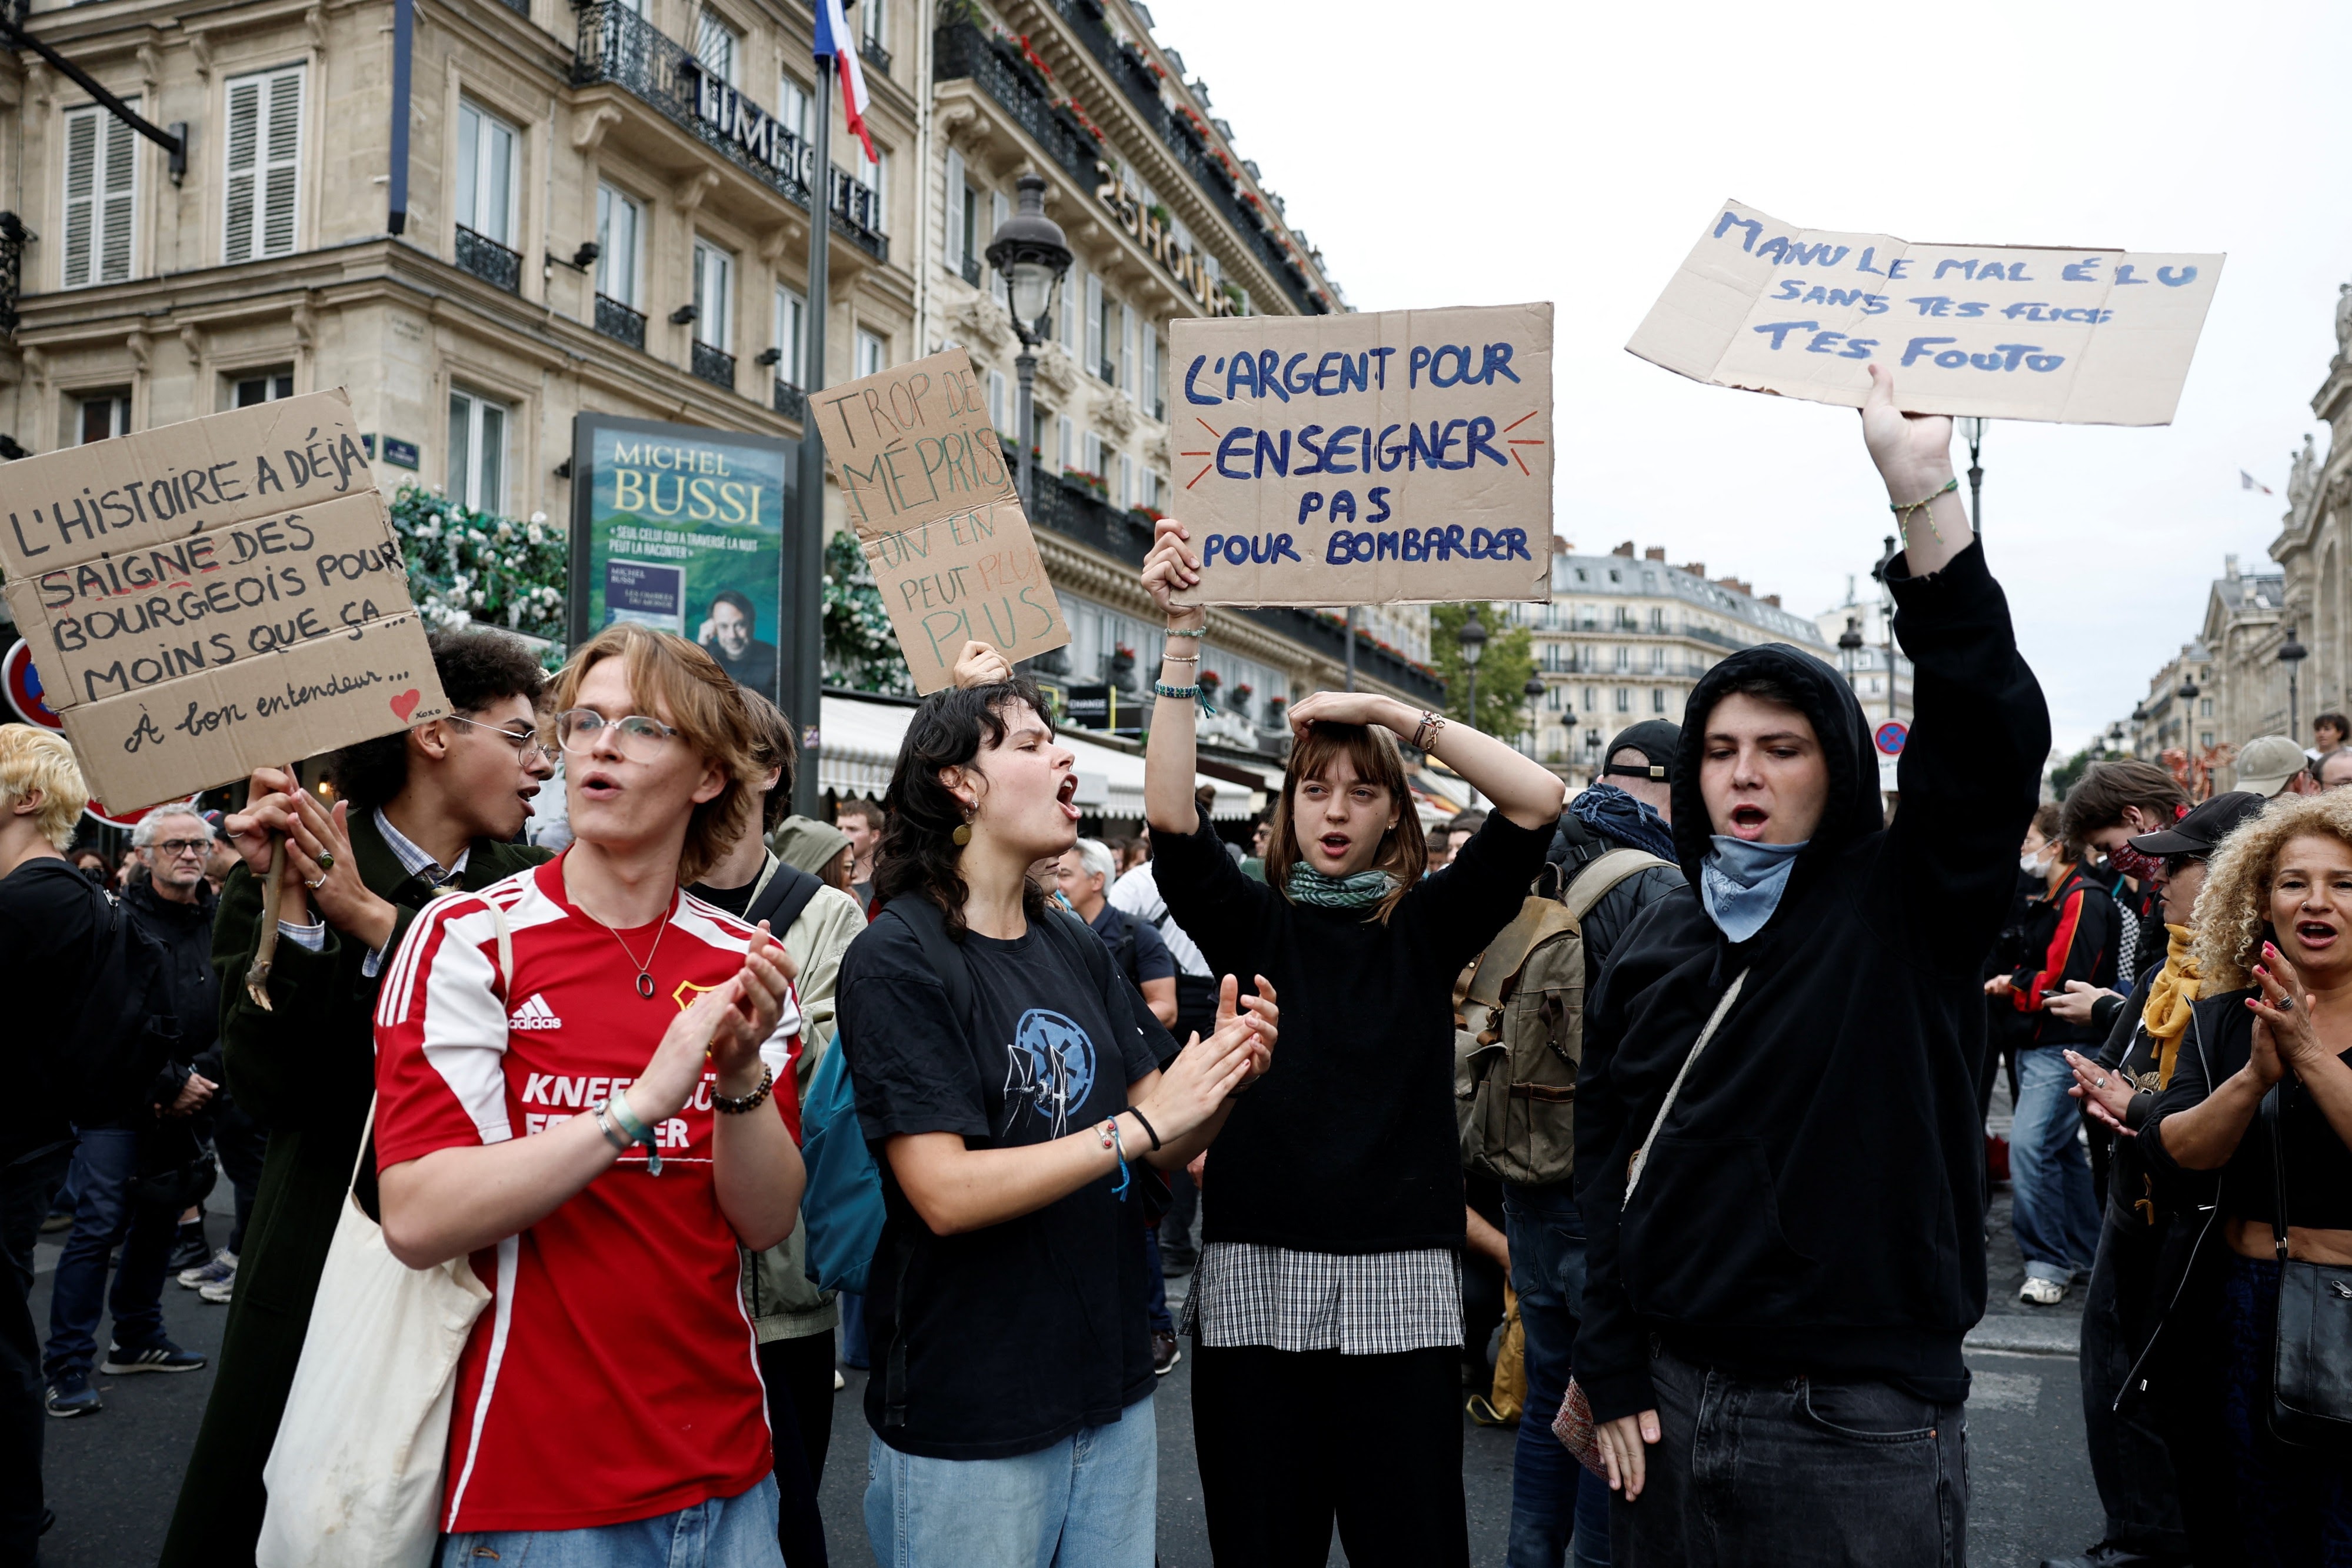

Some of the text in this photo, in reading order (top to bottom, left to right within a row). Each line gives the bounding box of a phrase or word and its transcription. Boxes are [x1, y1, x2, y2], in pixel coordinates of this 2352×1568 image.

[1714, 212, 1852, 266] MANU
[1856, 247, 1914, 279] LE
[1933, 259, 2034, 282] MAL
[1770, 280, 2115, 325] SANS TES FLICS
[1184, 342, 1521, 405] L'ARGENT POUR
[822, 369, 981, 448] TROP DE
[614, 441, 730, 477] MICHEL
[1216, 416, 1508, 479] ENSEIGNER
[256, 456, 284, 496] A
[611, 469, 763, 525] BUSSI
[1298, 487, 1391, 525] PAS
[228, 515, 314, 566] DES
[609, 539, 631, 553] PEUT
[632, 541, 642, 555] LA
[643, 542, 687, 559] RACONTER
[617, 525, 638, 541] SEUL
[639, 528, 662, 542] CELUI
[663, 530, 678, 544] QUI
[678, 532, 686, 545] A
[687, 532, 727, 549] TRAVERSÉ
[727, 537, 738, 550] LA
[739, 539, 758, 552] NUIT
[878, 504, 996, 569] ON EN
[1204, 525, 1531, 567] POUR BOMBARDER
[315, 541, 405, 586] POUR
[611, 567, 645, 579] MICHEL
[611, 576, 635, 585] BUSSI
[900, 547, 1041, 612] PEUT PLUS
[248, 608, 329, 654] QUE
[1068, 699, 1107, 709] CHANGE
[124, 704, 165, 753] À
[175, 702, 246, 737] bon
[508, 1016, 561, 1030] adidas
